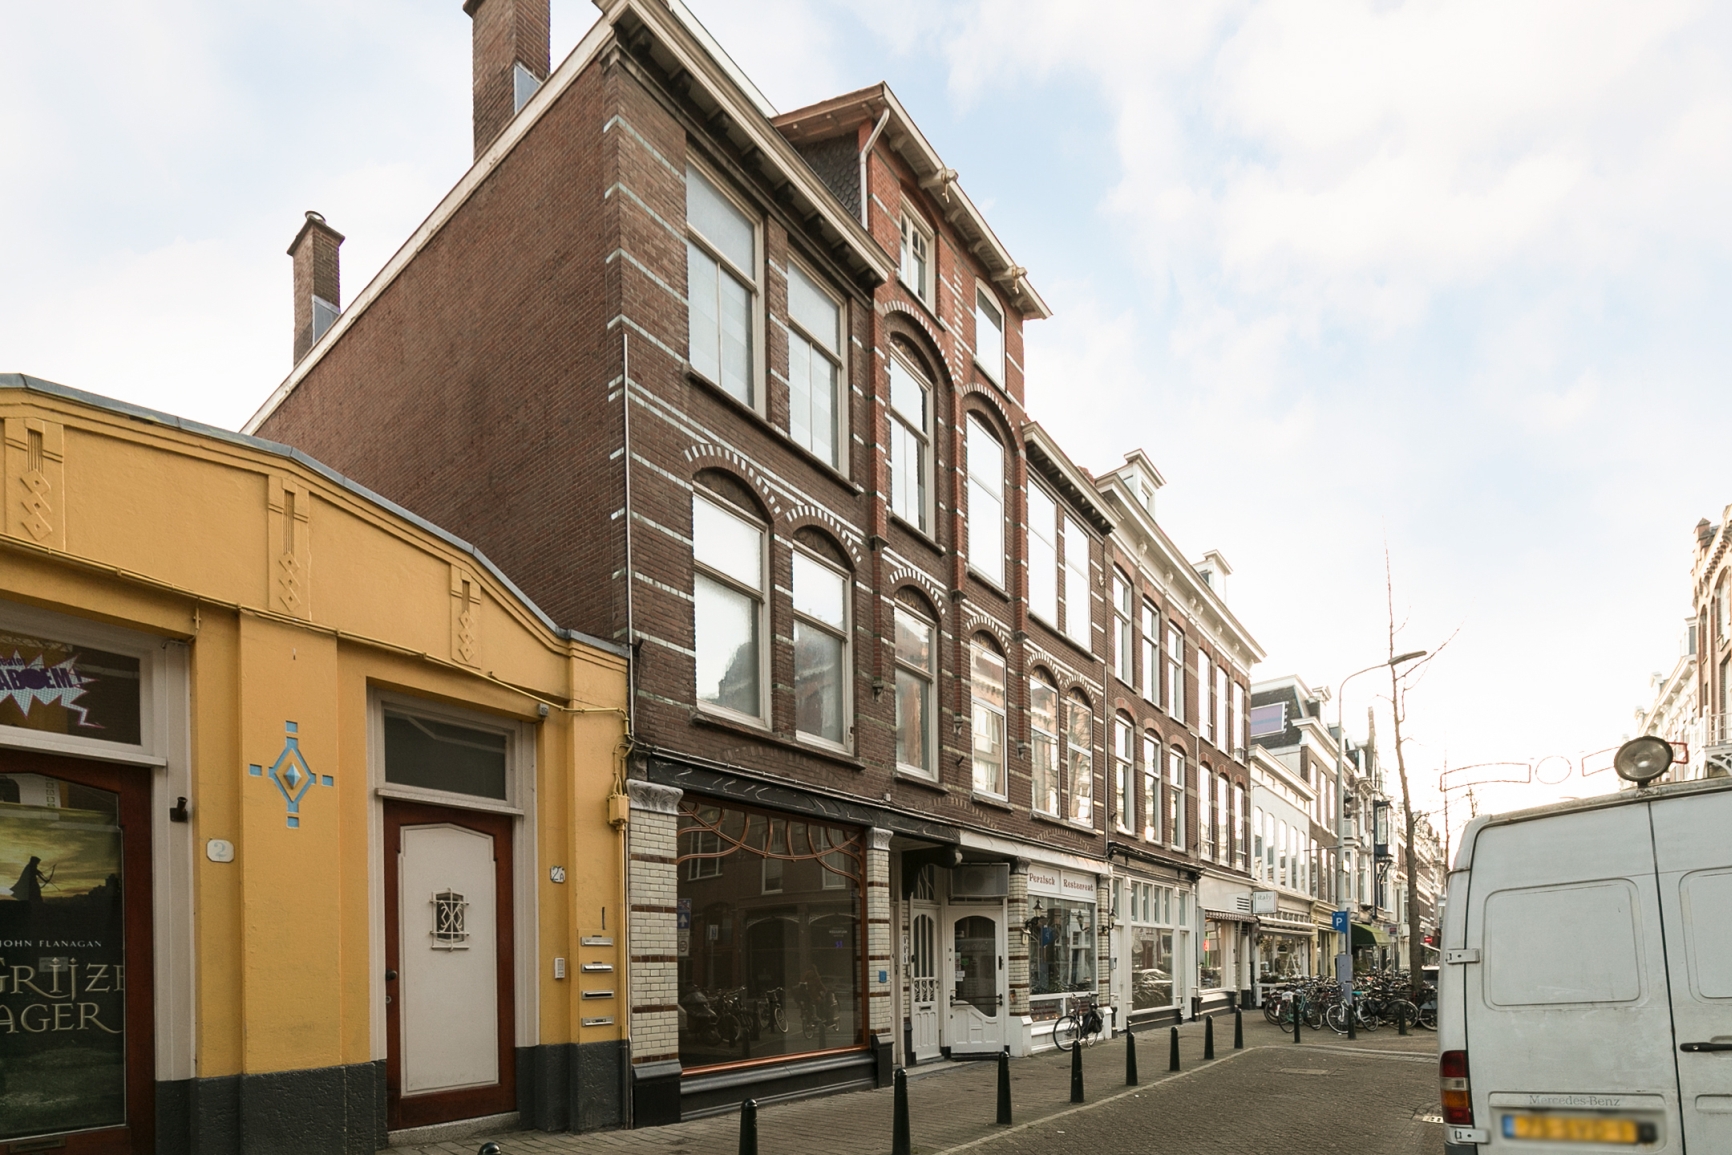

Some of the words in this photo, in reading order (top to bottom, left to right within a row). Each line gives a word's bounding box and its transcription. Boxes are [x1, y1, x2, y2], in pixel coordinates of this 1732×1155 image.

[213, 841, 227, 858] 2
[1336, 917, 1343, 927] P
[39, 940, 102, 948] FLANAGAN
[1529, 1095, 1621, 1107] Mercedes-Benz
